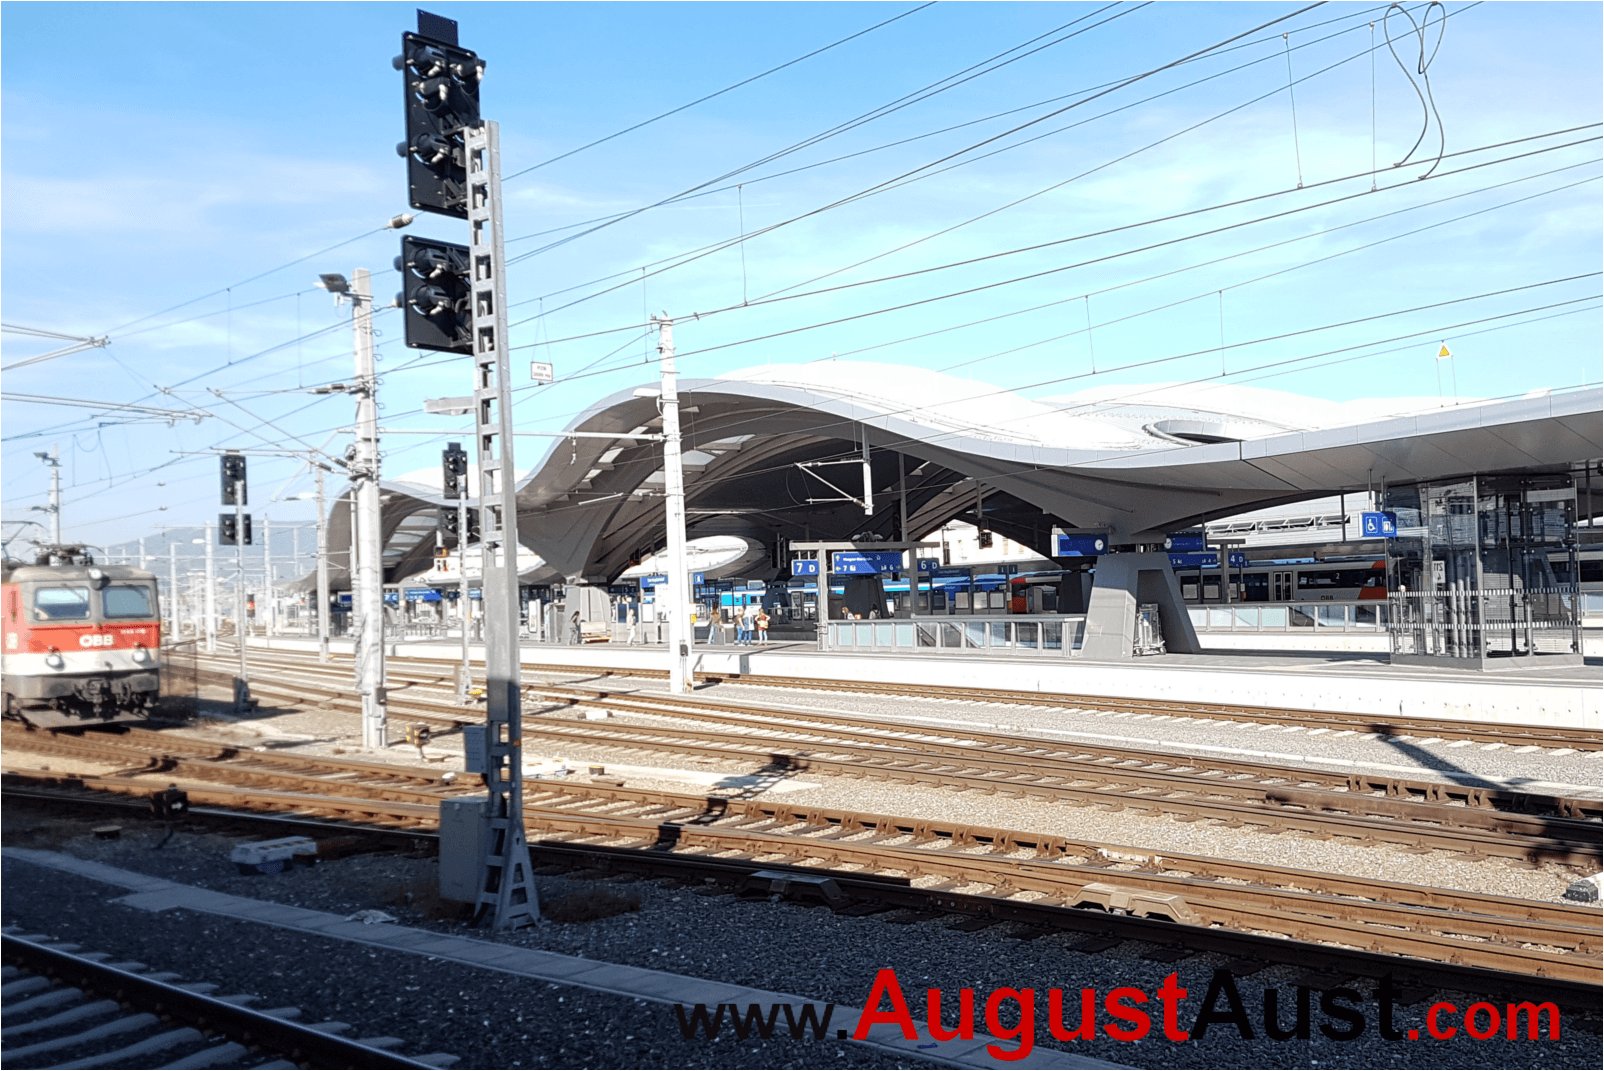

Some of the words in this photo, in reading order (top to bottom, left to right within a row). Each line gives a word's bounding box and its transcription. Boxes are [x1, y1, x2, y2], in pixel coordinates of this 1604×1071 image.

[1230, 555, 1236, 563] 4
[796, 563, 803, 572] 7
[809, 564, 816, 572] D
[920, 560, 927, 569] 6
